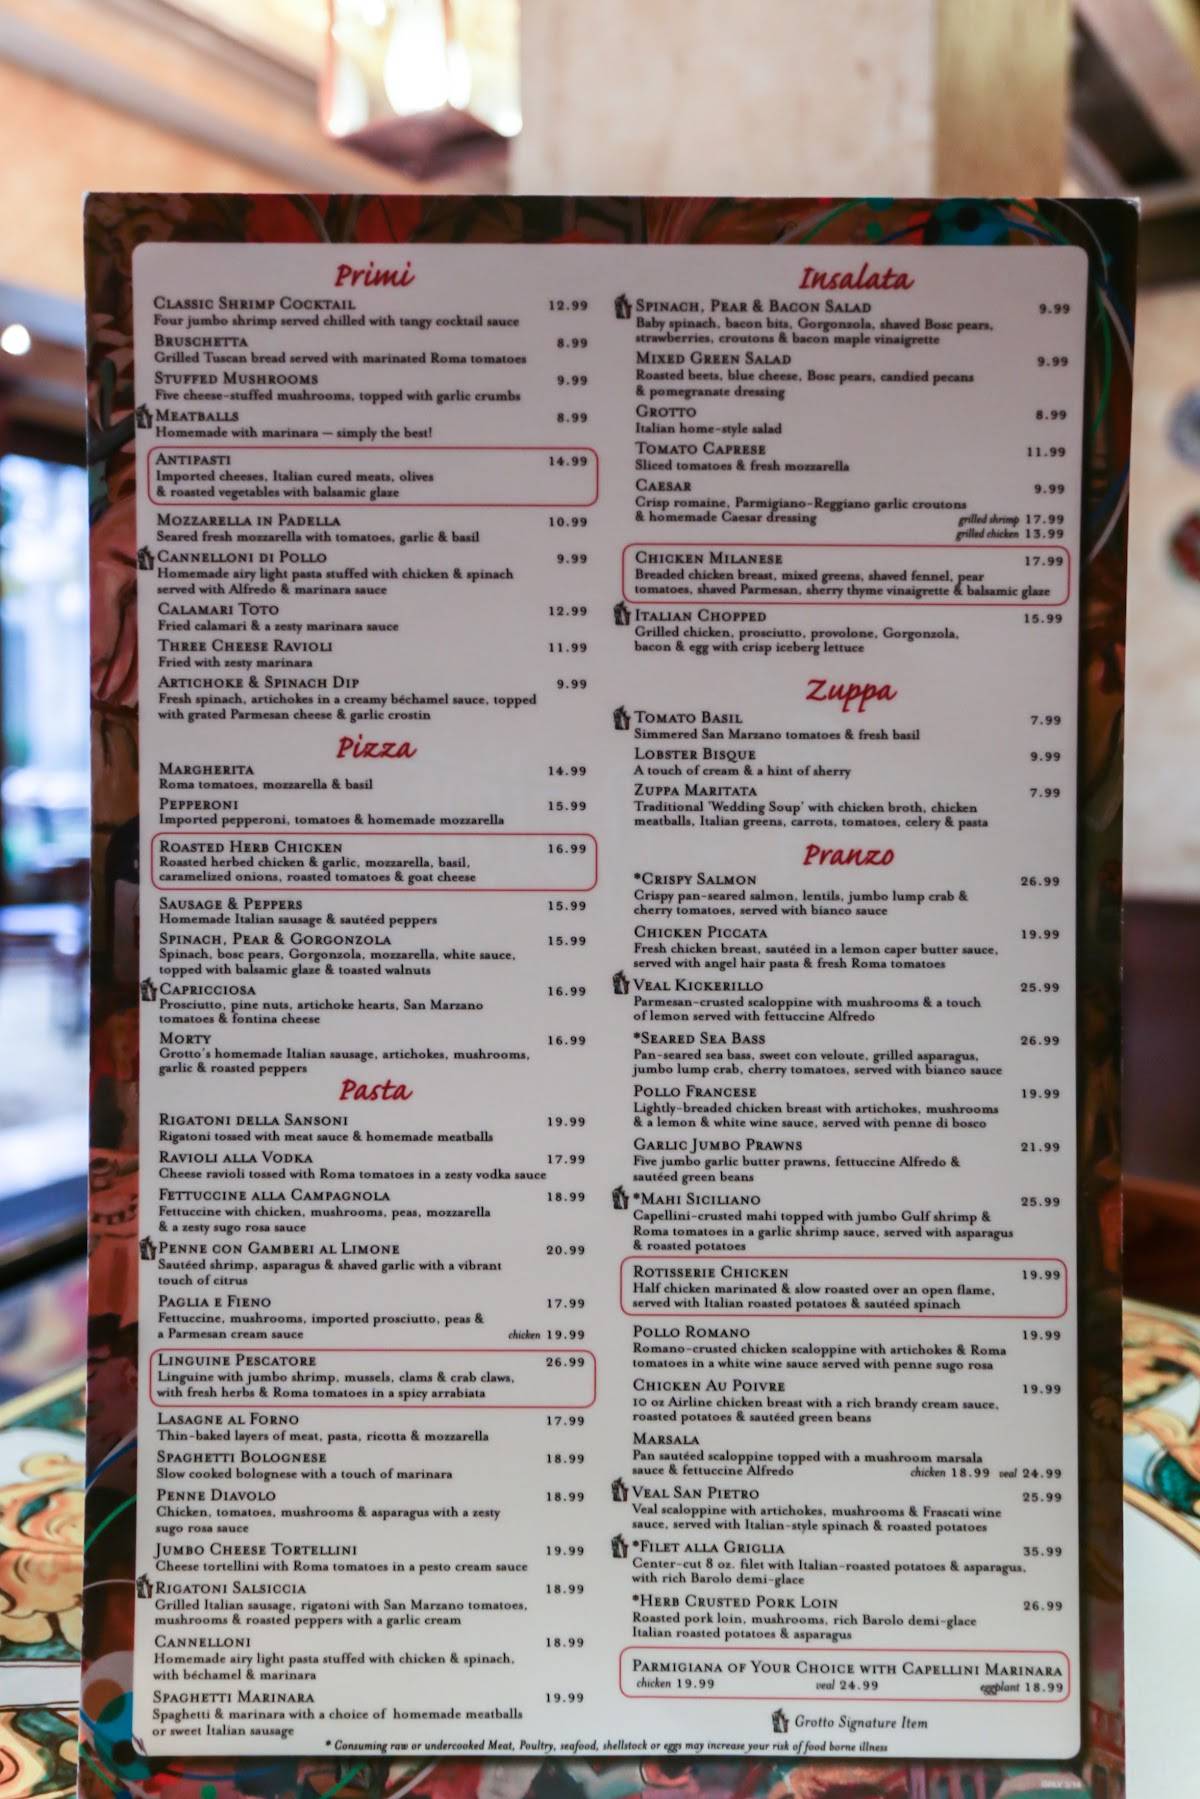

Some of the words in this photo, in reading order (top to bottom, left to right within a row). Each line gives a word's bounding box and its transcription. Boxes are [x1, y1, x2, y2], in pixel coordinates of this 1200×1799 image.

[334, 261, 416, 287] Primi
[798, 262, 915, 290] Insalata
[153, 296, 214, 310] CLASSIC
[219, 296, 275, 310] SHRIMP
[279, 296, 356, 310] COCKTAIL
[549, 300, 588, 311] 12.99
[154, 314, 184, 325] Four
[186, 314, 228, 329] jumbo
[232, 314, 277, 330] shrimp
[281, 314, 319, 326] served
[323, 314, 365, 326] chilled
[369, 314, 396, 326] with
[400, 318, 432, 330] tangy
[435, 314, 483, 327] cocktail
[487, 319, 519, 327] sauce
[154, 334, 248, 347] BRUSCHETTA
[557, 338, 588, 349] 8.99
[636, 351, 685, 364] MIXED
[690, 351, 740, 365] GREEN
[745, 351, 791, 365] SALAD
[1037, 356, 1068, 367] 9.99
[154, 371, 218, 384] STUFFED
[223, 371, 318, 385] MUSHROOMS
[557, 375, 588, 386] 9.99
[156, 409, 239, 422] MEATBALLS
[557, 412, 587, 423] 8.99
[636, 404, 696, 418] GROTTO
[1036, 410, 1067, 420] 8.99
[635, 422, 675, 434] Italian
[679, 422, 748, 436] home-style
[752, 422, 782, 434] salad
[156, 453, 230, 465] ANTIPASTI
[549, 456, 587, 466] 14.99
[157, 470, 215, 485] Imported
[219, 470, 268, 482] cheeses,
[273, 470, 313, 481] Italian
[317, 470, 352, 482] cured
[356, 473, 394, 482] meats,
[399, 470, 434, 482] olives
[635, 478, 691, 492] CAESAR
[1034, 484, 1065, 494] 9.99
[957, 513, 988, 527] grilled
[989, 513, 1020, 527] shrimp
[1025, 513, 1065, 525] 17.99
[635, 551, 703, 564] CHICKEN
[709, 551, 783, 565] MILANESE
[1025, 556, 1063, 566] 17.99
[635, 609, 692, 621] ITALIAN
[698, 609, 766, 622] CHOPPED
[1025, 613, 1062, 624] 15.99
[157, 639, 206, 652] THREE
[212, 639, 268, 652] CHEESE
[274, 639, 332, 652] RAVIOLI
[549, 643, 587, 653] 11.99
[159, 657, 191, 667] Fried
[194, 657, 220, 667] with
[225, 660, 252, 671] zesty
[256, 658, 312, 667] marinara
[805, 679, 898, 713] Zuppa
[633, 710, 696, 724] TOMATO
[701, 711, 743, 724] BASIL
[1030, 715, 1061, 725] 7.99
[336, 734, 417, 759] Pizza
[634, 747, 698, 760] LOBSTER
[703, 747, 756, 762] BISQUE
[1030, 752, 1061, 762] 9.99
[159, 762, 254, 775] MARGHERITA
[549, 766, 586, 776] 14.99
[159, 778, 194, 789] Roma
[198, 781, 257, 790] tomatoes,
[262, 778, 327, 790] mozzarella
[331, 778, 341, 790] &
[345, 778, 373, 790] basil
[160, 798, 238, 810] PEPPERONI
[549, 801, 586, 811] 15.99
[160, 840, 224, 853] ROASTED
[230, 840, 269, 853] HERB
[275, 840, 342, 853] CHICKEN
[549, 844, 586, 854] 16.99
[802, 843, 895, 866] Pranzo
[634, 925, 702, 938] CHICKEN
[708, 926, 768, 938] PICCATA
[1022, 929, 1059, 939] 19.99
[160, 983, 256, 995] CAPRICCIOSA
[548, 986, 586, 996] 16.99
[633, 978, 671, 991] VEAL
[675, 979, 763, 991] KICKERILLO
[1020, 982, 1059, 992] 25.99
[633, 1010, 648, 1021] of
[650, 1010, 689, 1021] lemon
[693, 1010, 731, 1021] served
[734, 1010, 760, 1021] with
[764, 1010, 825, 1021] fettuccine
[828, 1010, 875, 1022] Alfredo
[339, 1078, 413, 1101] Pasta
[634, 1137, 687, 1150] GARLIC
[690, 1138, 740, 1154] JUMBO
[746, 1138, 802, 1151] PRAWNS
[1021, 1142, 1060, 1152] 21.99
[159, 1151, 217, 1163] RAVIOLI
[223, 1154, 257, 1163] ALLA
[261, 1151, 313, 1163] VODKA
[548, 1154, 585, 1164] 17.99
[633, 1265, 715, 1278] ROTISSERIE
[721, 1265, 788, 1278] CHICKEN
[1022, 1270, 1060, 1280] 19.99
[508, 1329, 540, 1340] chicken
[548, 1330, 584, 1340] 19.99
[158, 1353, 230, 1366] LINGUINE
[236, 1353, 316, 1366] PESCATORE
[546, 1357, 584, 1367] 26.99
[633, 1432, 699, 1445] MARSALA
[157, 1450, 234, 1463] SPAGHETTI
[241, 1450, 326, 1463] BOLOGNESE
[547, 1454, 584, 1464] 18.99
[910, 1466, 946, 1477] chicken
[952, 1468, 990, 1478] 18.99
[999, 1468, 1017, 1478] veal
[1022, 1468, 1061, 1479] 24.99
[632, 1486, 669, 1498] VEAL
[674, 1486, 701, 1498] SAN
[708, 1486, 759, 1499] PIETRO
[1022, 1492, 1062, 1502] 25.99
[155, 1635, 250, 1648] CANNELLONI
[547, 1638, 584, 1648] 18.99
[795, 1715, 834, 1727] Grotto
[839, 1715, 896, 1732] Signature
[902, 1716, 927, 1728] Item
[170, 1728, 201, 1736] sweet
[207, 1724, 246, 1735] Italian
[250, 1728, 294, 1739] sausage
[334, 1740, 388, 1754] Consuming
[390, 1742, 408, 1751] raw
[411, 1742, 422, 1751] or
[425, 1740, 485, 1751] undercooked
[488, 1740, 515, 1752] Meat,
[519, 1740, 556, 1754] Poultry,
[560, 1740, 599, 1754] seafood,
[603, 1739, 648, 1751] shellstock
[650, 1742, 661, 1751] or
[663, 1742, 682, 1754] eggs
[685, 1742, 704, 1754] may
[707, 1740, 745, 1751] increase
[744, 1742, 770, 1754] your
[773, 1740, 789, 1751] risk
[792, 1739, 804, 1754] of
[802, 1739, 827, 1754] food
[829, 1740, 856, 1752] borne
[859, 1741, 888, 1752] illness
